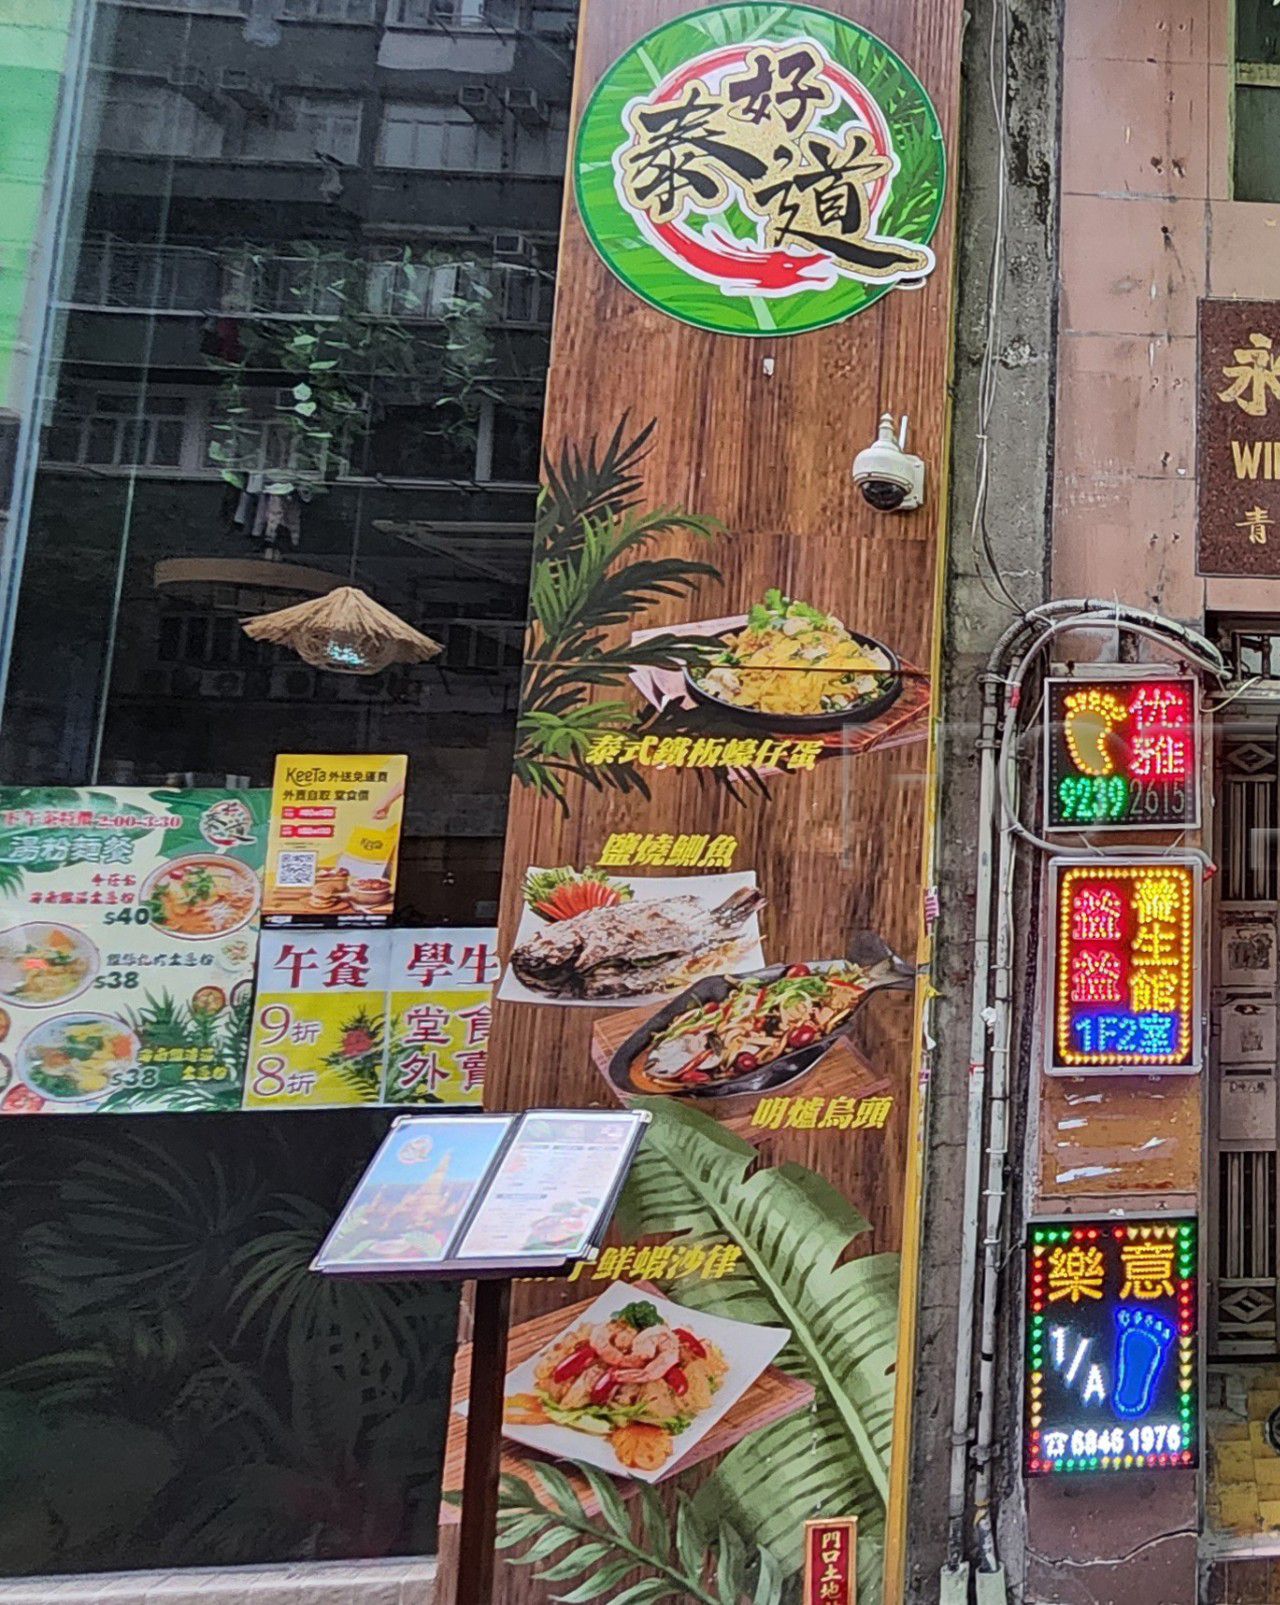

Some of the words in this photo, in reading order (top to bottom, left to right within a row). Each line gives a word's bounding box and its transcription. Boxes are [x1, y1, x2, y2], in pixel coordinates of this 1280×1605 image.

[1129, 687, 1185, 776] 优雅
[1129, 778, 1185, 815] 2615
[274, 943, 371, 988] 午餐
[407, 942, 500, 987] 學生
[260, 1004, 320, 1045] 9折
[253, 1056, 317, 1097] 8折
[515, 1244, 742, 1282] 鮮蝦沙律
[1048, 1242, 1175, 1302] 樂意
[1128, 1424, 1181, 1453] 1976
[820, 1530, 843, 1605] 門口土地
